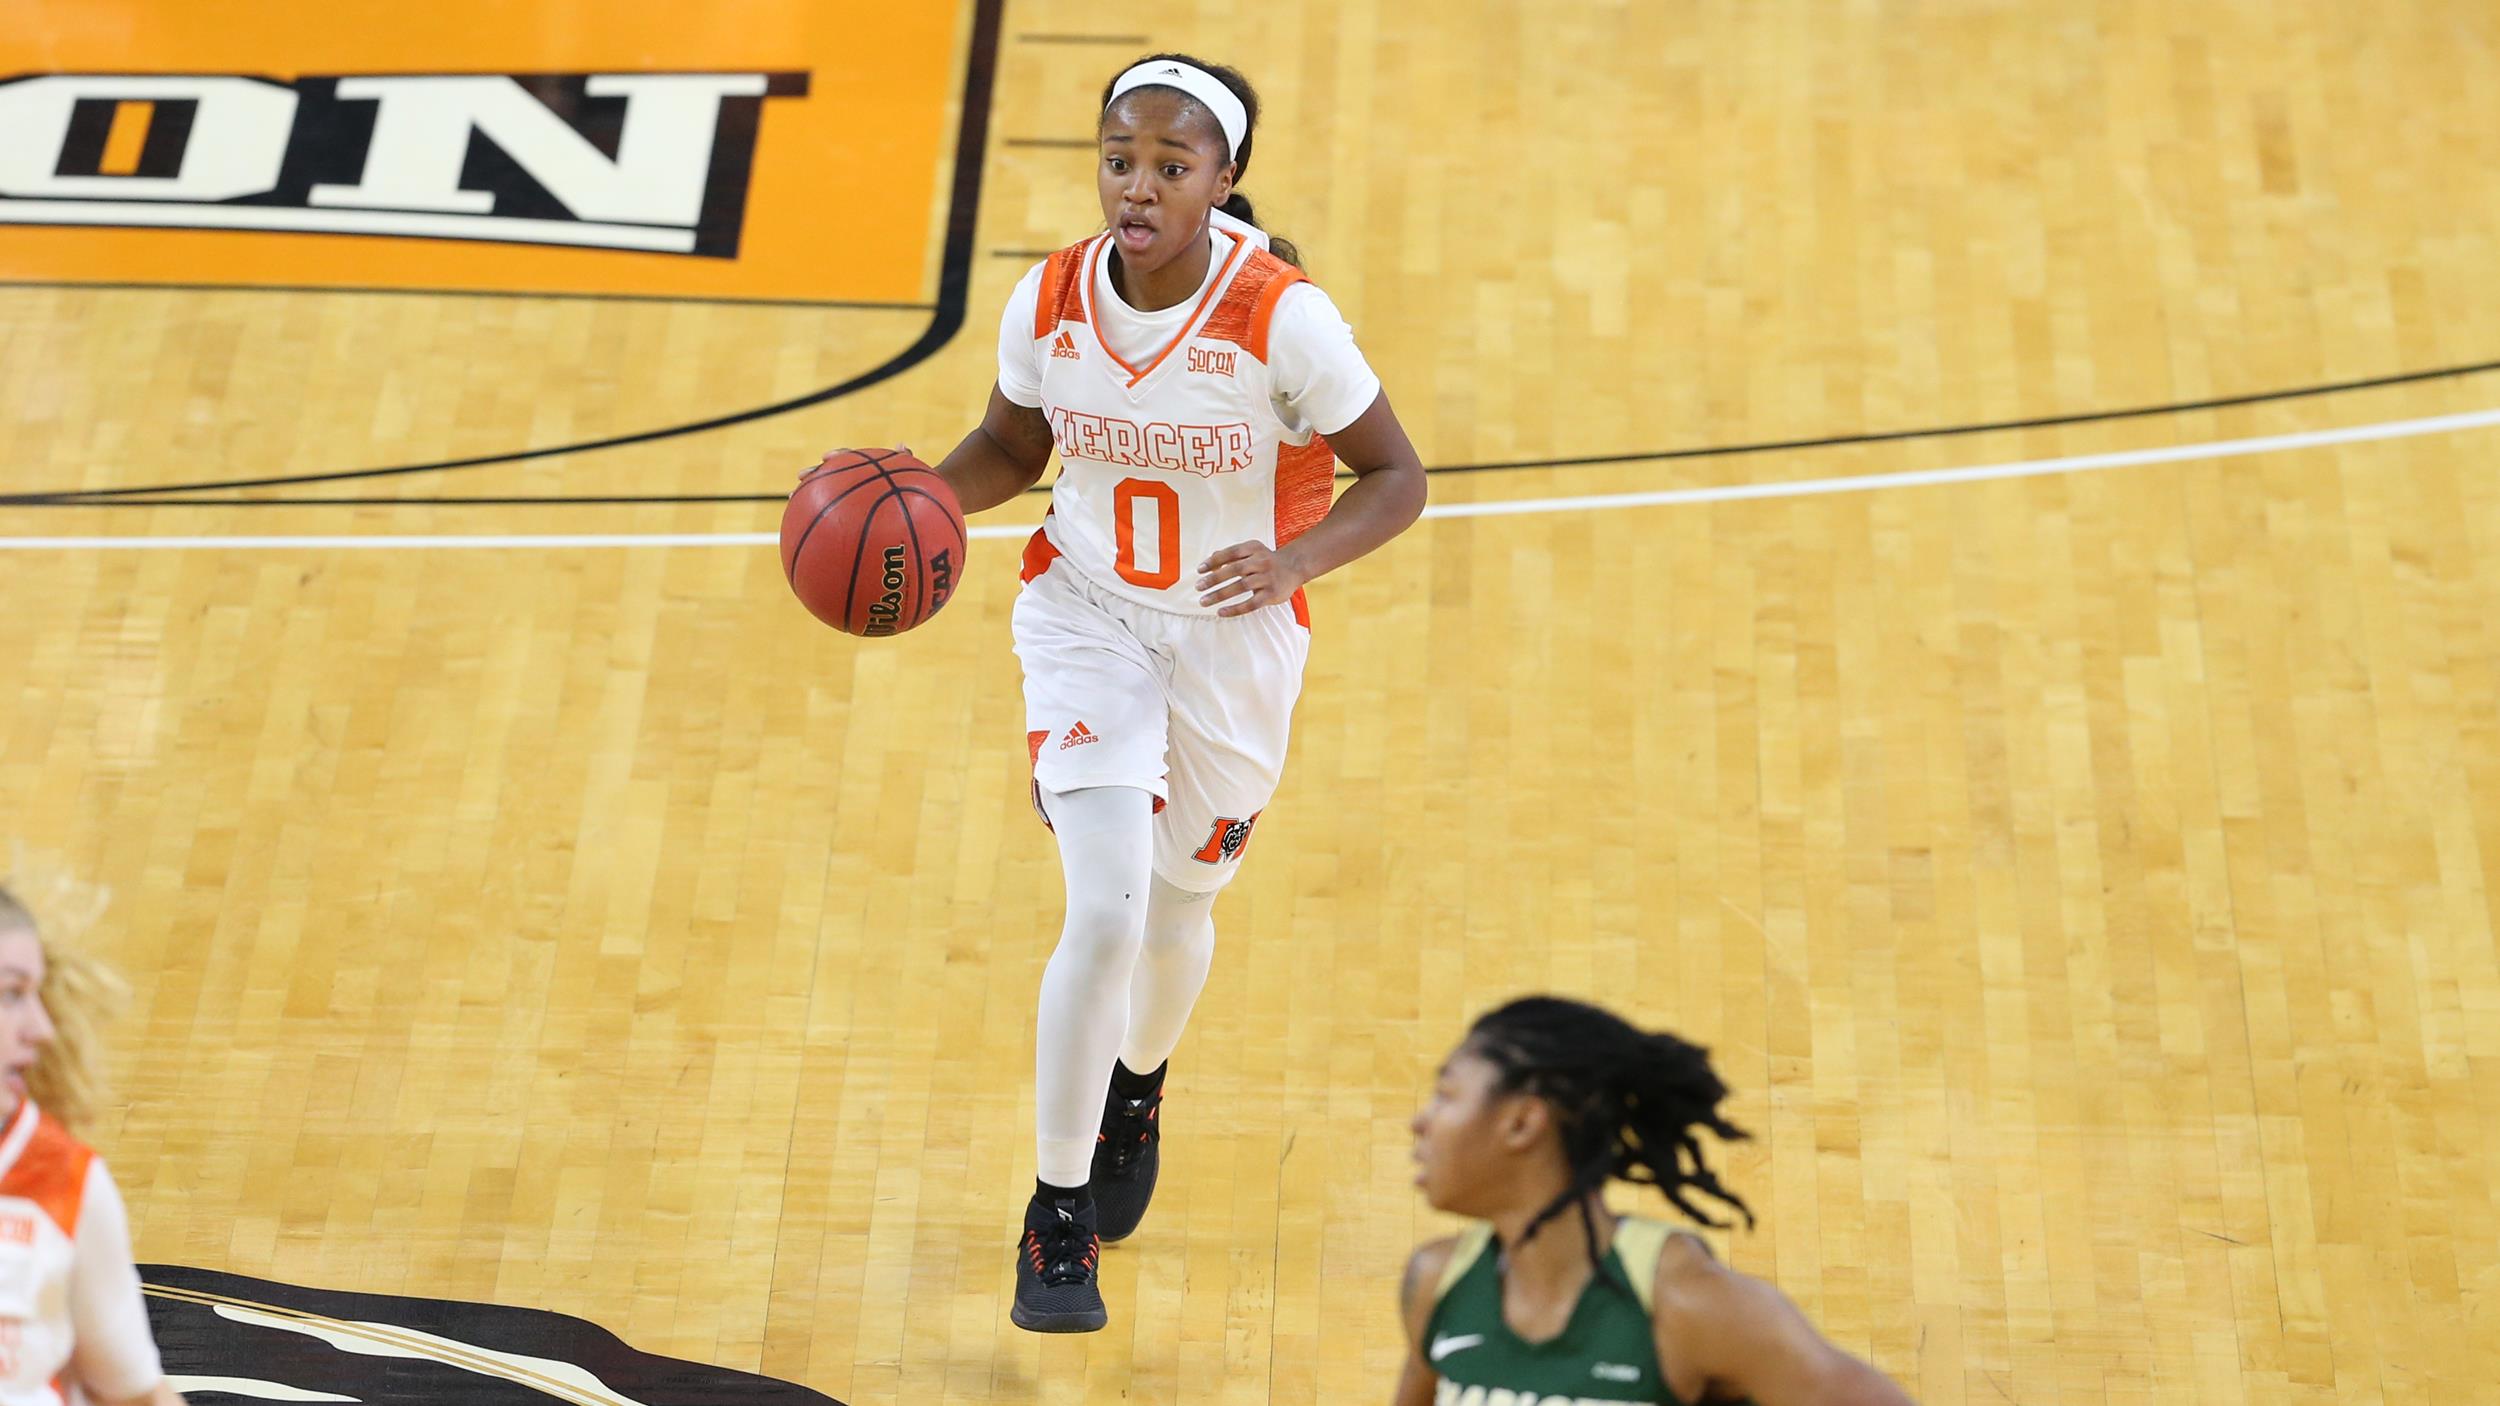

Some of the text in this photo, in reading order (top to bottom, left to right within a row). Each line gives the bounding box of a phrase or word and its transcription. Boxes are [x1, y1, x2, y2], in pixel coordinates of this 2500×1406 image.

[1050, 347, 1080, 360] didas
[1113, 477, 1181, 590] 0
[928, 548, 952, 614] CAA
[1060, 735, 1099, 750] adidas
